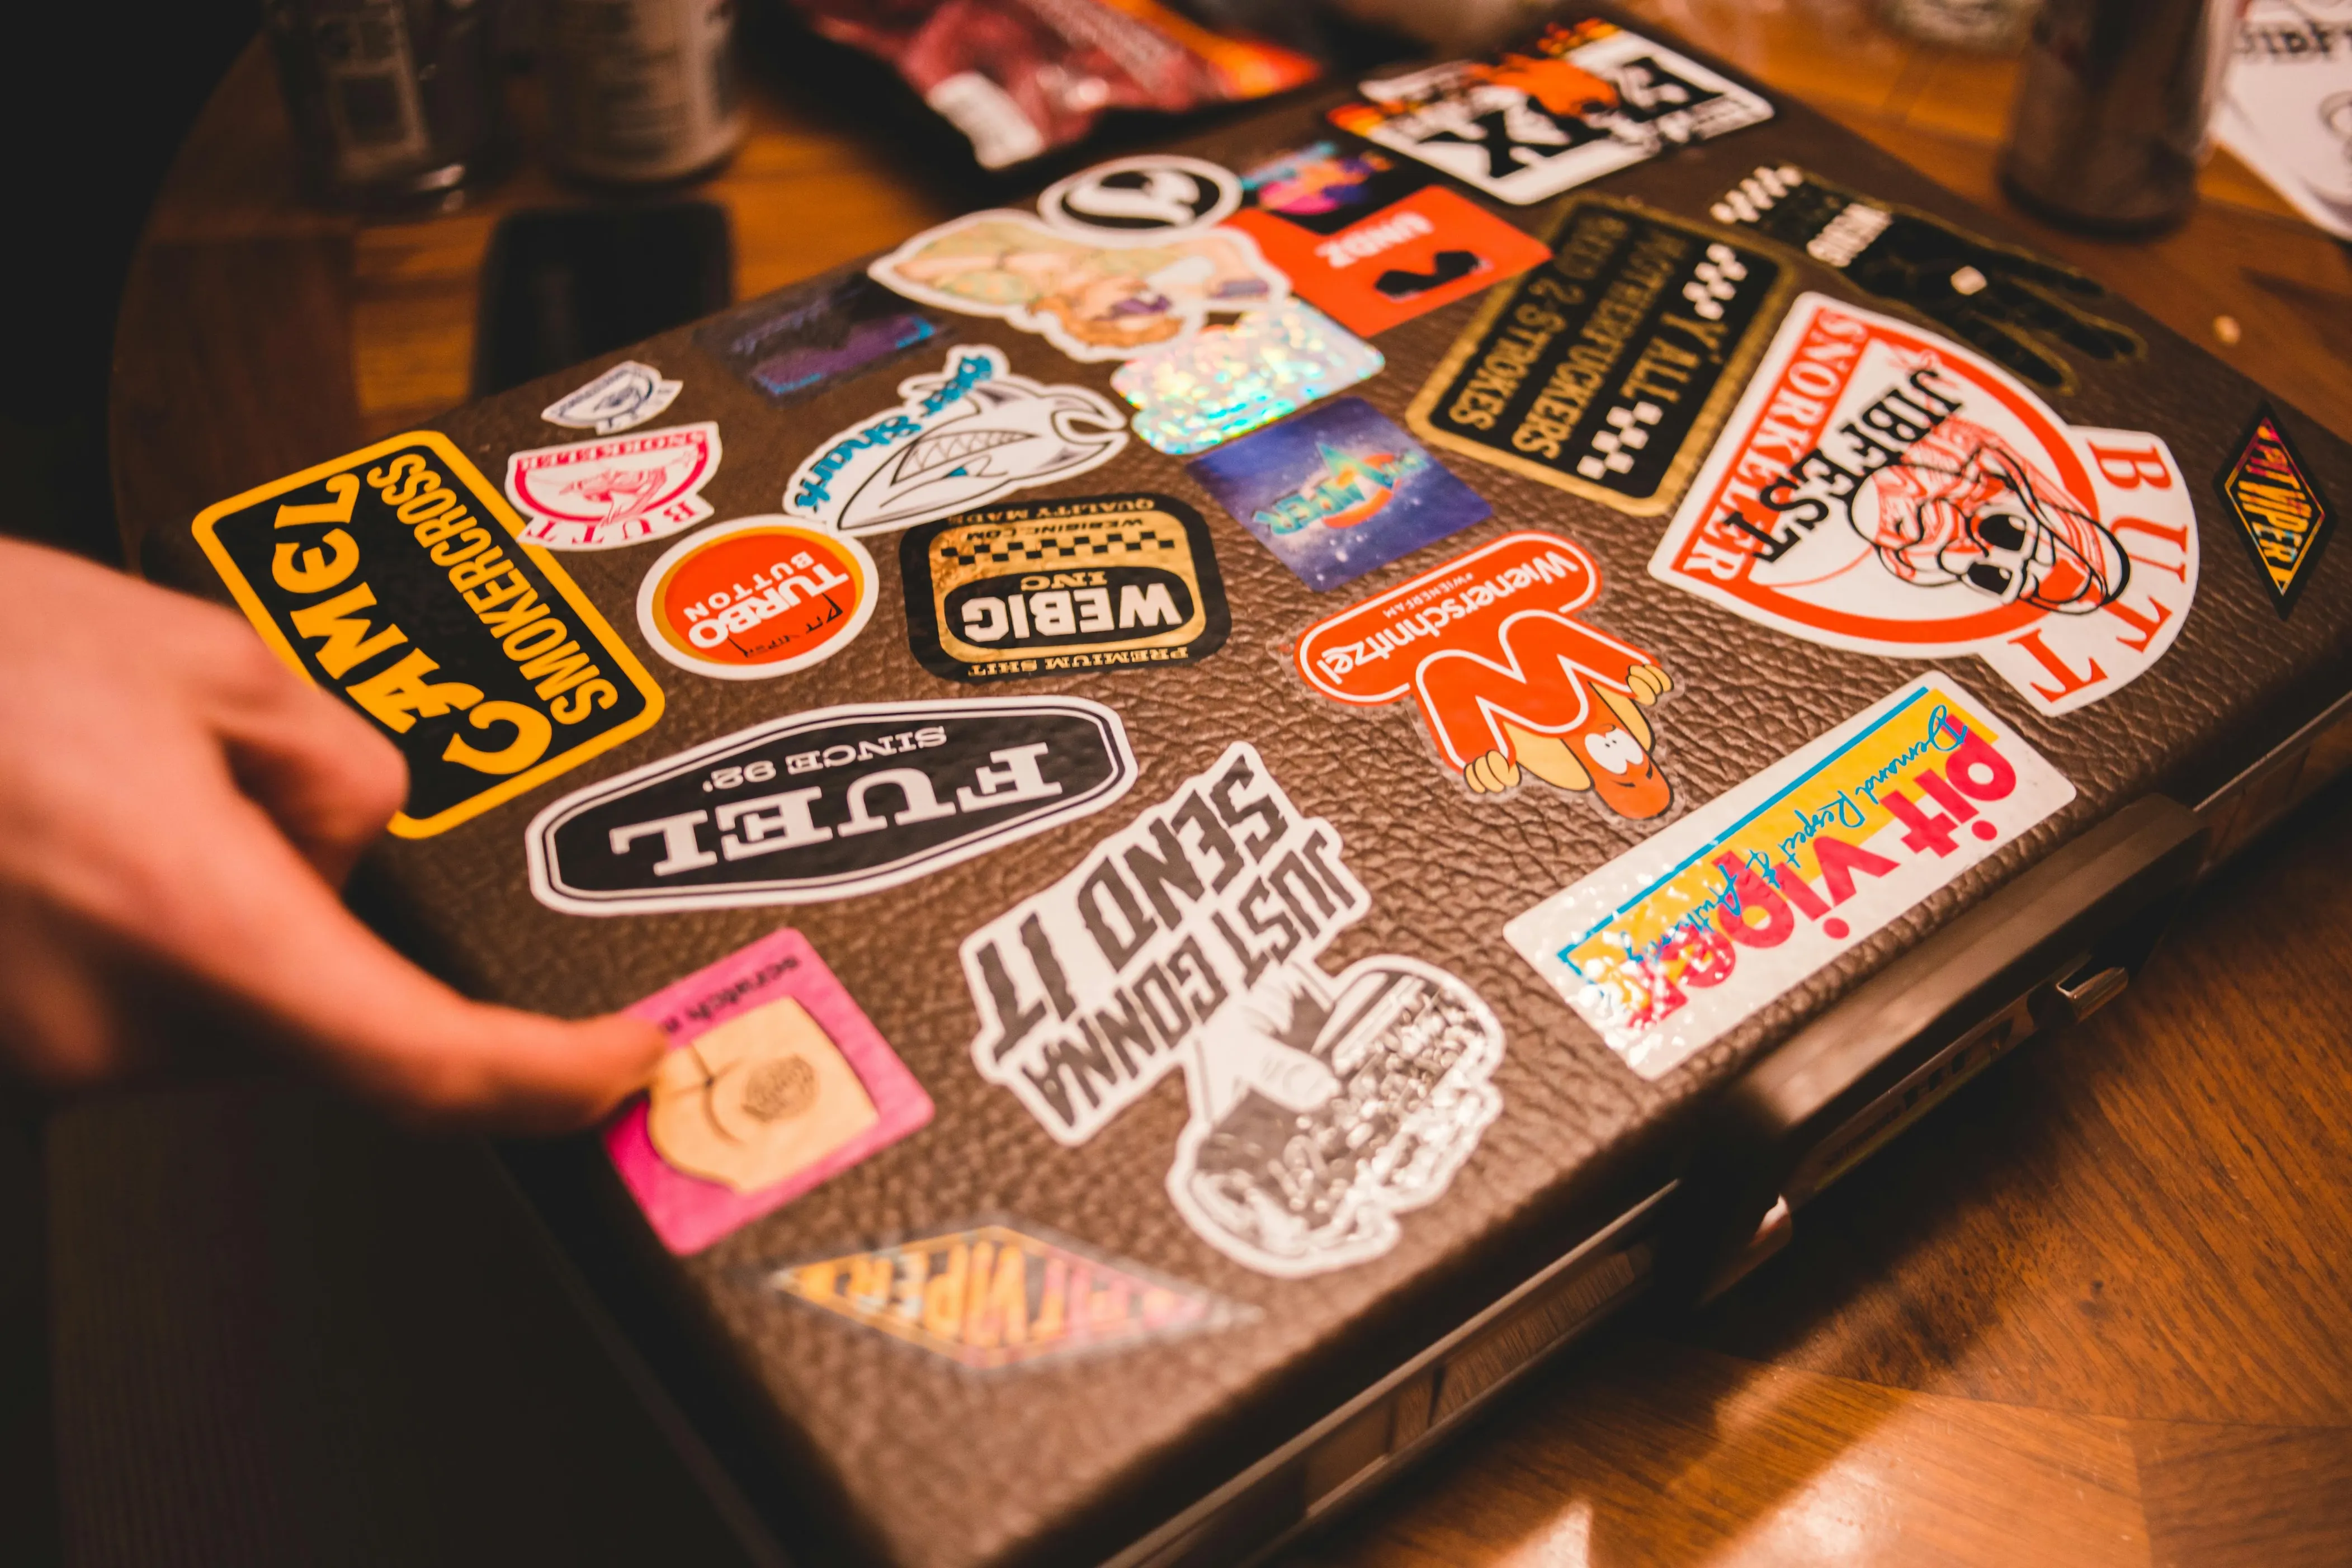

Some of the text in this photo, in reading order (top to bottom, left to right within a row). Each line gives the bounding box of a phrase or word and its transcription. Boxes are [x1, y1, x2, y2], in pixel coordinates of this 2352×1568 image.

[795, 416, 922, 512] Shark
[1683, 307, 1869, 580] SNORKELER
[1723, 369, 1963, 563] JIBFEST
[527, 501, 697, 545] BUTT
[1036, 499, 1155, 519] QUALITY
[366, 454, 618, 725] SMOKERCROSS
[683, 551, 815, 622] BUTTON
[688, 563, 849, 649] TURBO
[961, 582, 1182, 643] WEBIG
[1021, 572, 1108, 592] INC
[1317, 551, 1578, 684] Wienerschnitzel
[2009, 440, 2188, 702] BUTT
[272, 473, 552, 774] CAMEL
[967, 646, 1189, 677] PREMIUM SHIT
[786, 726, 947, 775] SINCE
[1855, 705, 1968, 805] Demand
[610, 743, 1062, 876] FUEL
[1778, 790, 1866, 868] Respect
[975, 753, 1289, 1064] SEND IT
[1625, 714, 2016, 1029] pit viper
[1021, 830, 1355, 1127] JUST GONNA
